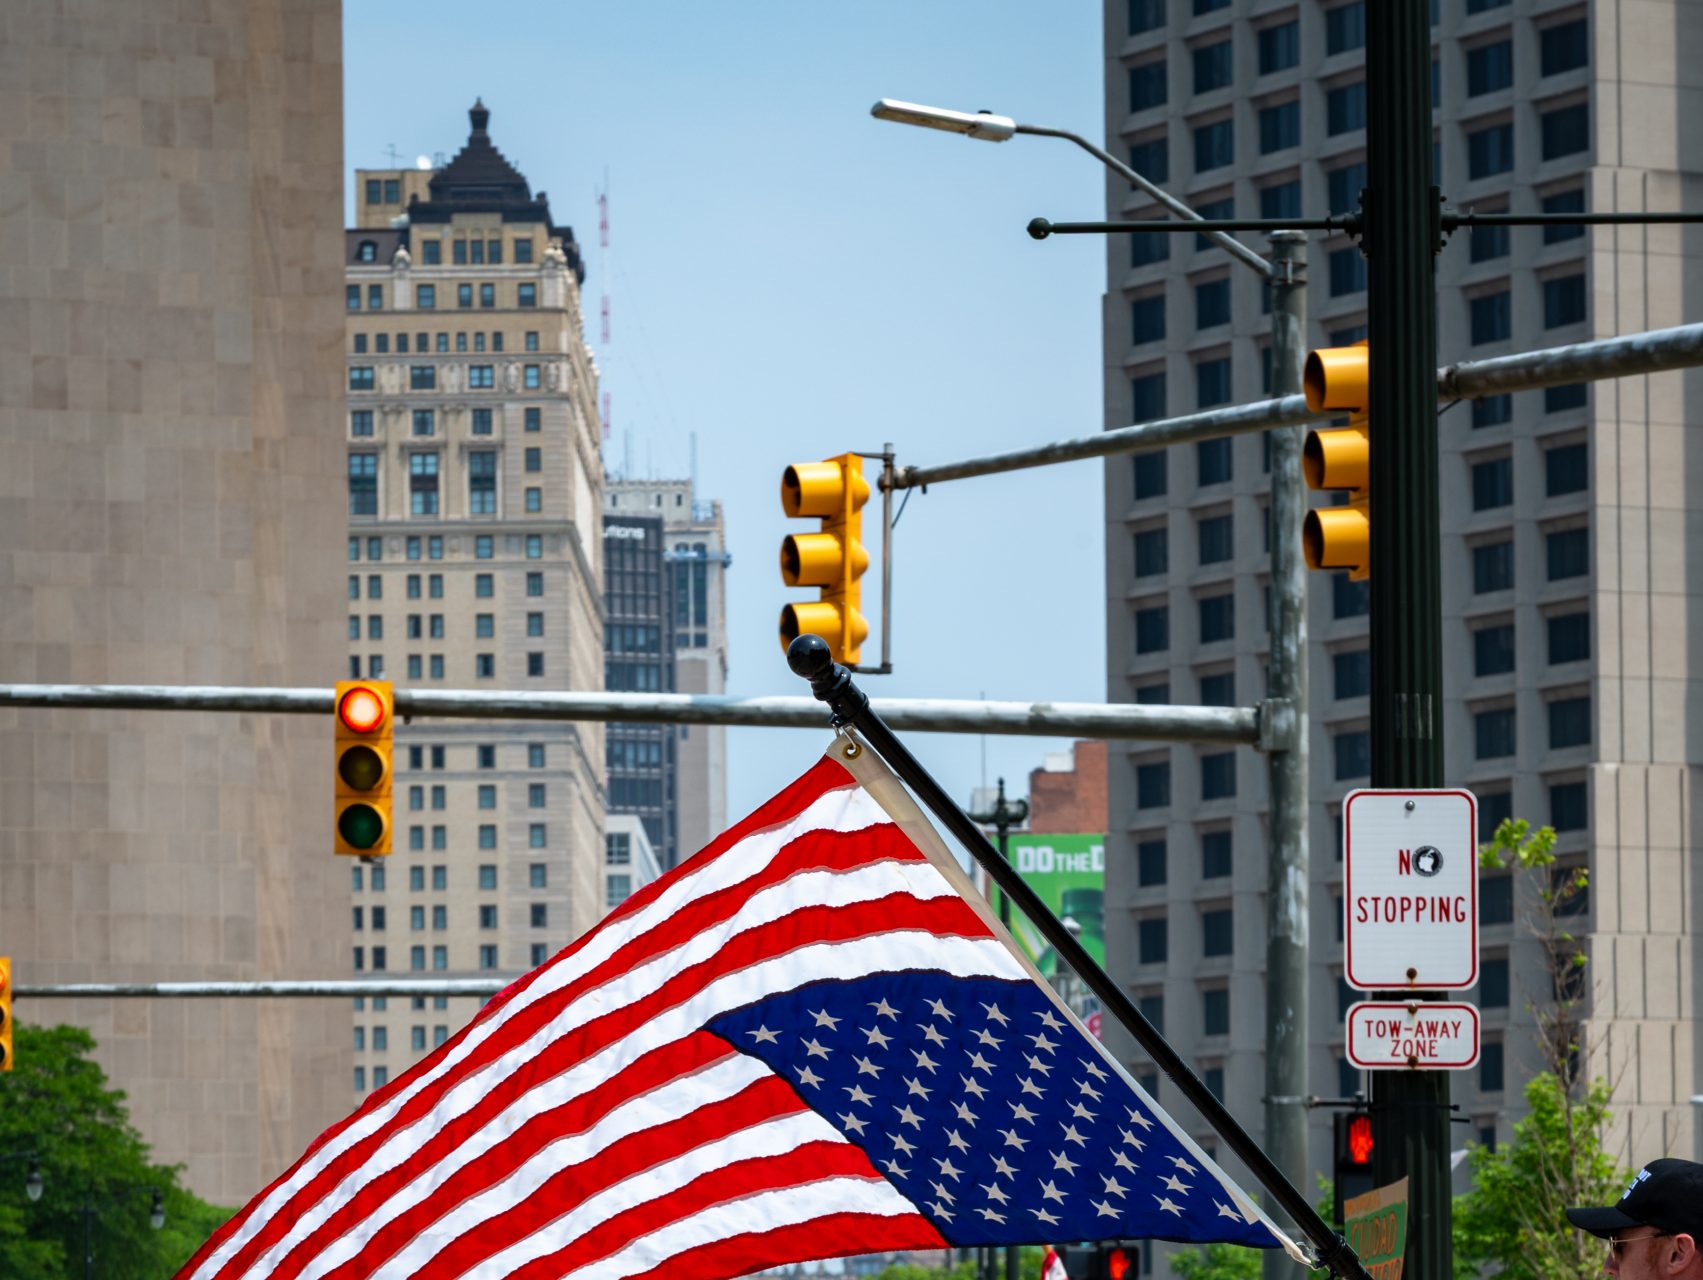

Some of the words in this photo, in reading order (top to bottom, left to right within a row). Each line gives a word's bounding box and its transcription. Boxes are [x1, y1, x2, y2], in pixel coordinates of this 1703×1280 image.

[1016, 846, 1054, 874] DO
[1055, 853, 1090, 873] THE
[1356, 896, 1467, 923] STOPPING
[1364, 1020, 1462, 1039] TOW-AWAY
[1391, 1039, 1438, 1058] ZONE
